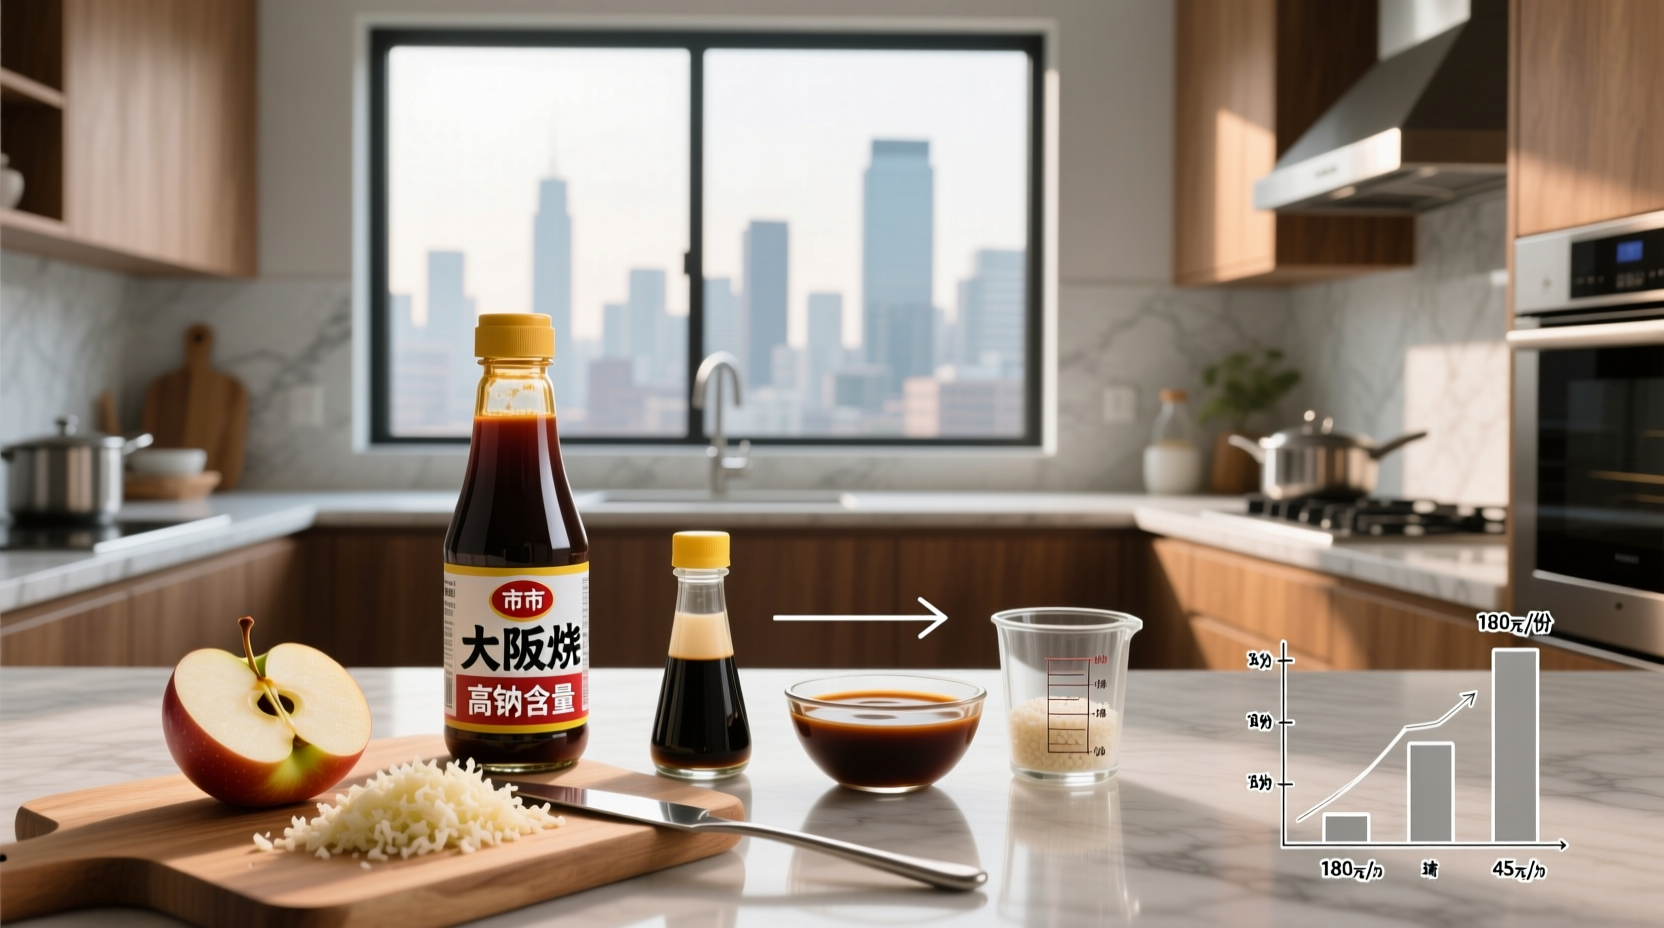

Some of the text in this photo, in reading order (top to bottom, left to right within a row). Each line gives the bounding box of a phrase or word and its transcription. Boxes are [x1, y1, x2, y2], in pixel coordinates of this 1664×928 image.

[502, 588, 545, 612] 市市
[461, 622, 582, 672] 大阪烧
[467, 682, 576, 718] 高钠含量
